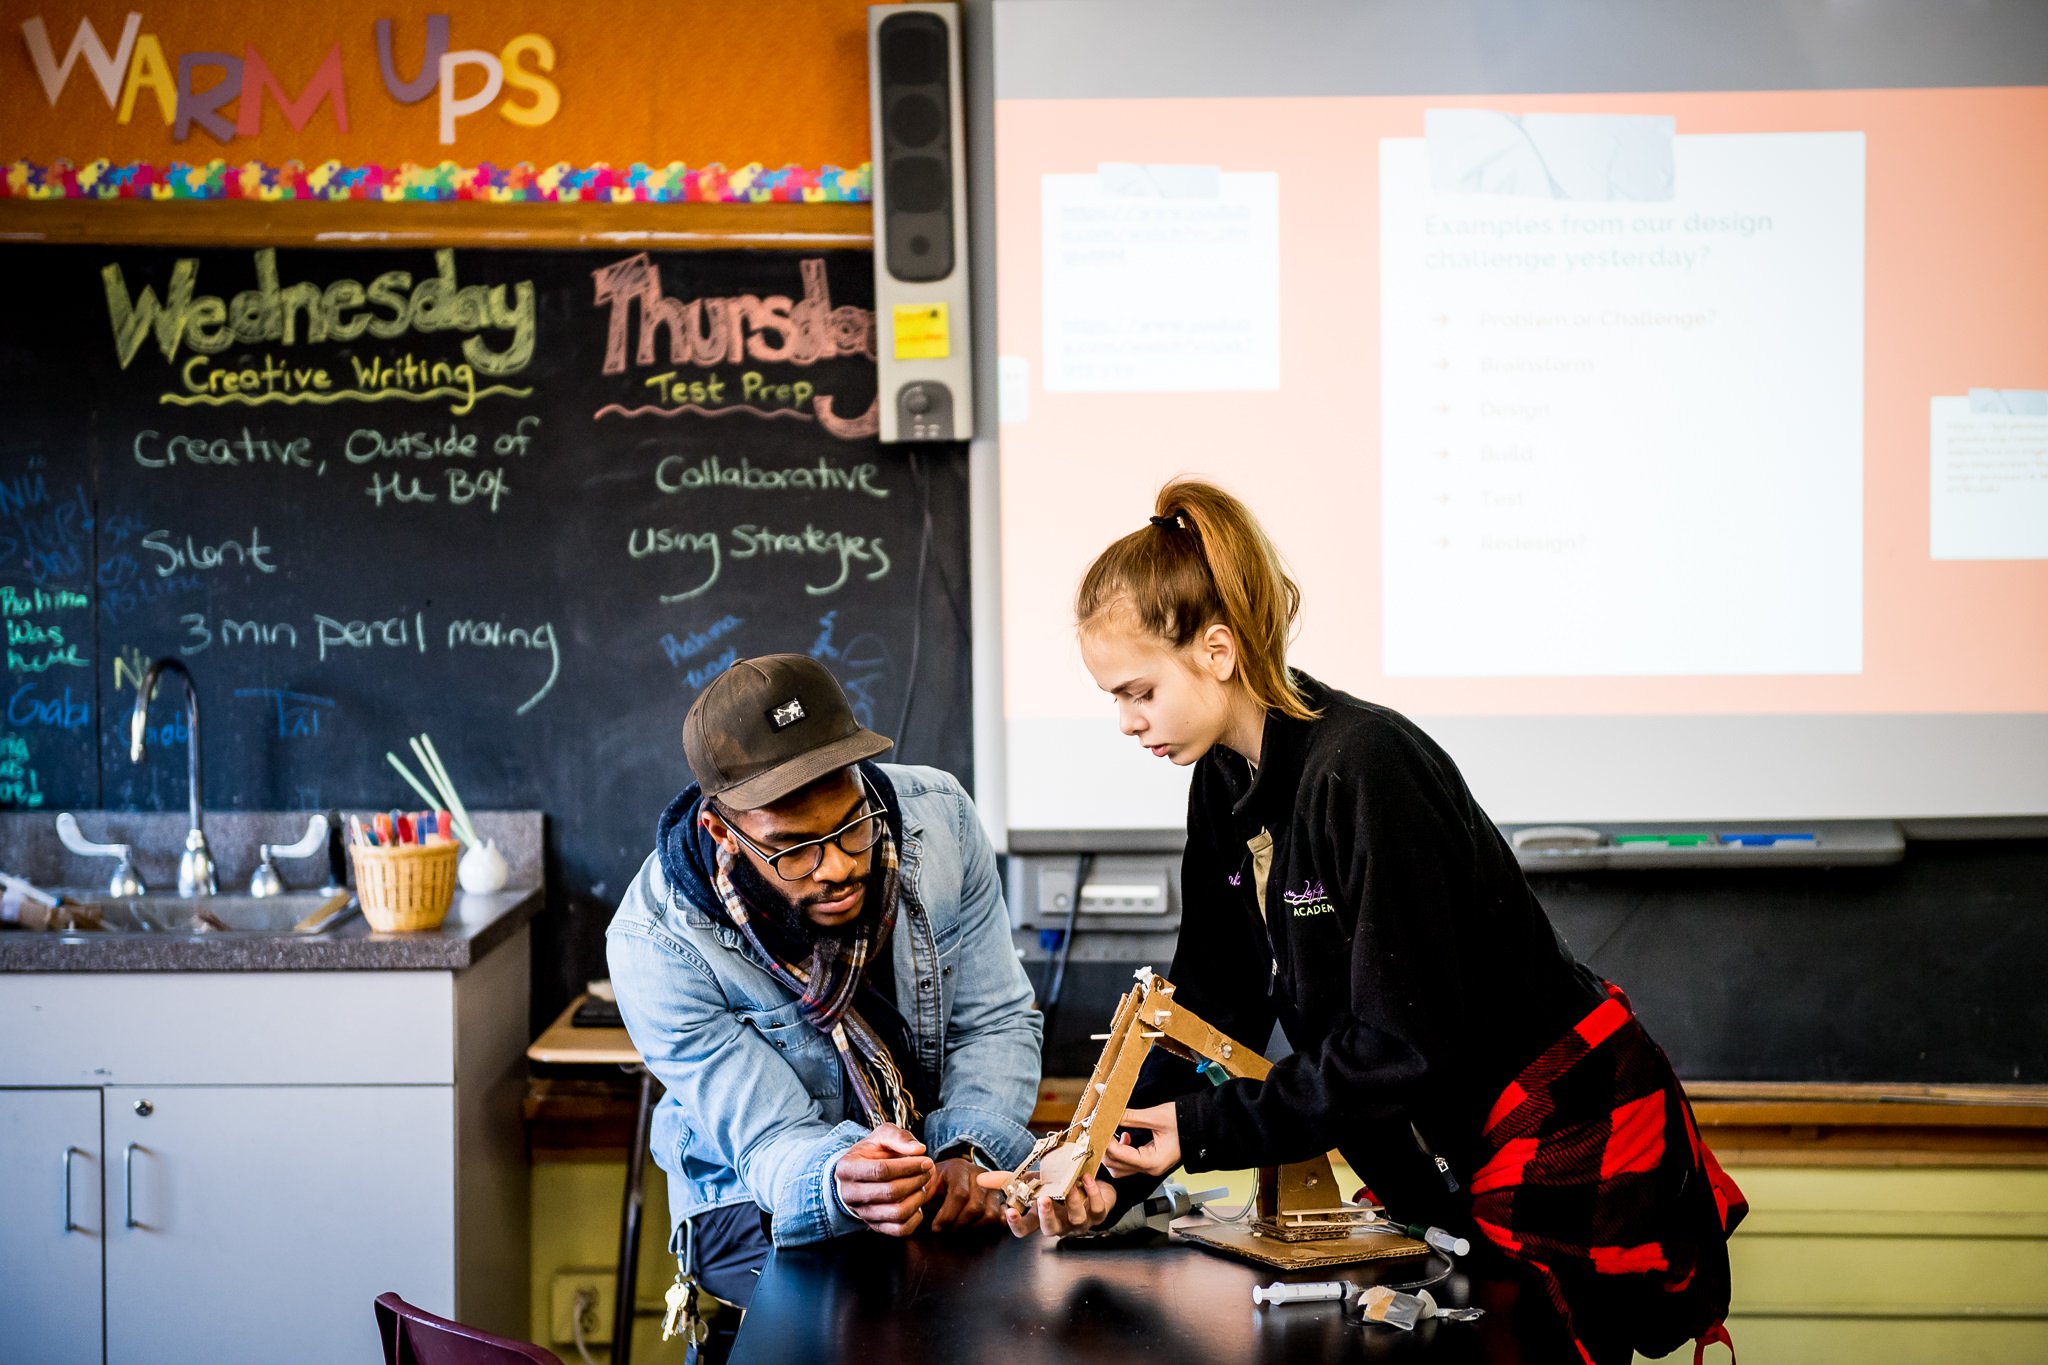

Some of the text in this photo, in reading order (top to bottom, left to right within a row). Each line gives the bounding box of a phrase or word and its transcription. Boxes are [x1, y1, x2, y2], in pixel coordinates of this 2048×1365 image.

[21, 12, 561, 144] WARM UPS
[1424, 210, 1774, 239] Examples from our design
[1424, 244, 1712, 273] challenge yesterday?
[101, 247, 537, 376] Wednesday
[182, 353, 476, 415] Creative Writing
[645, 371, 814, 408] Test Prep
[134, 416, 541, 475] Creative, Outside of
[444, 467, 511, 513] Box
[656, 455, 889, 498] Collaborative
[141, 526, 277, 577] Silent
[180, 612, 212, 655] 3
[222, 618, 297, 648] min
[1293, 903, 1335, 917] ACADEM
